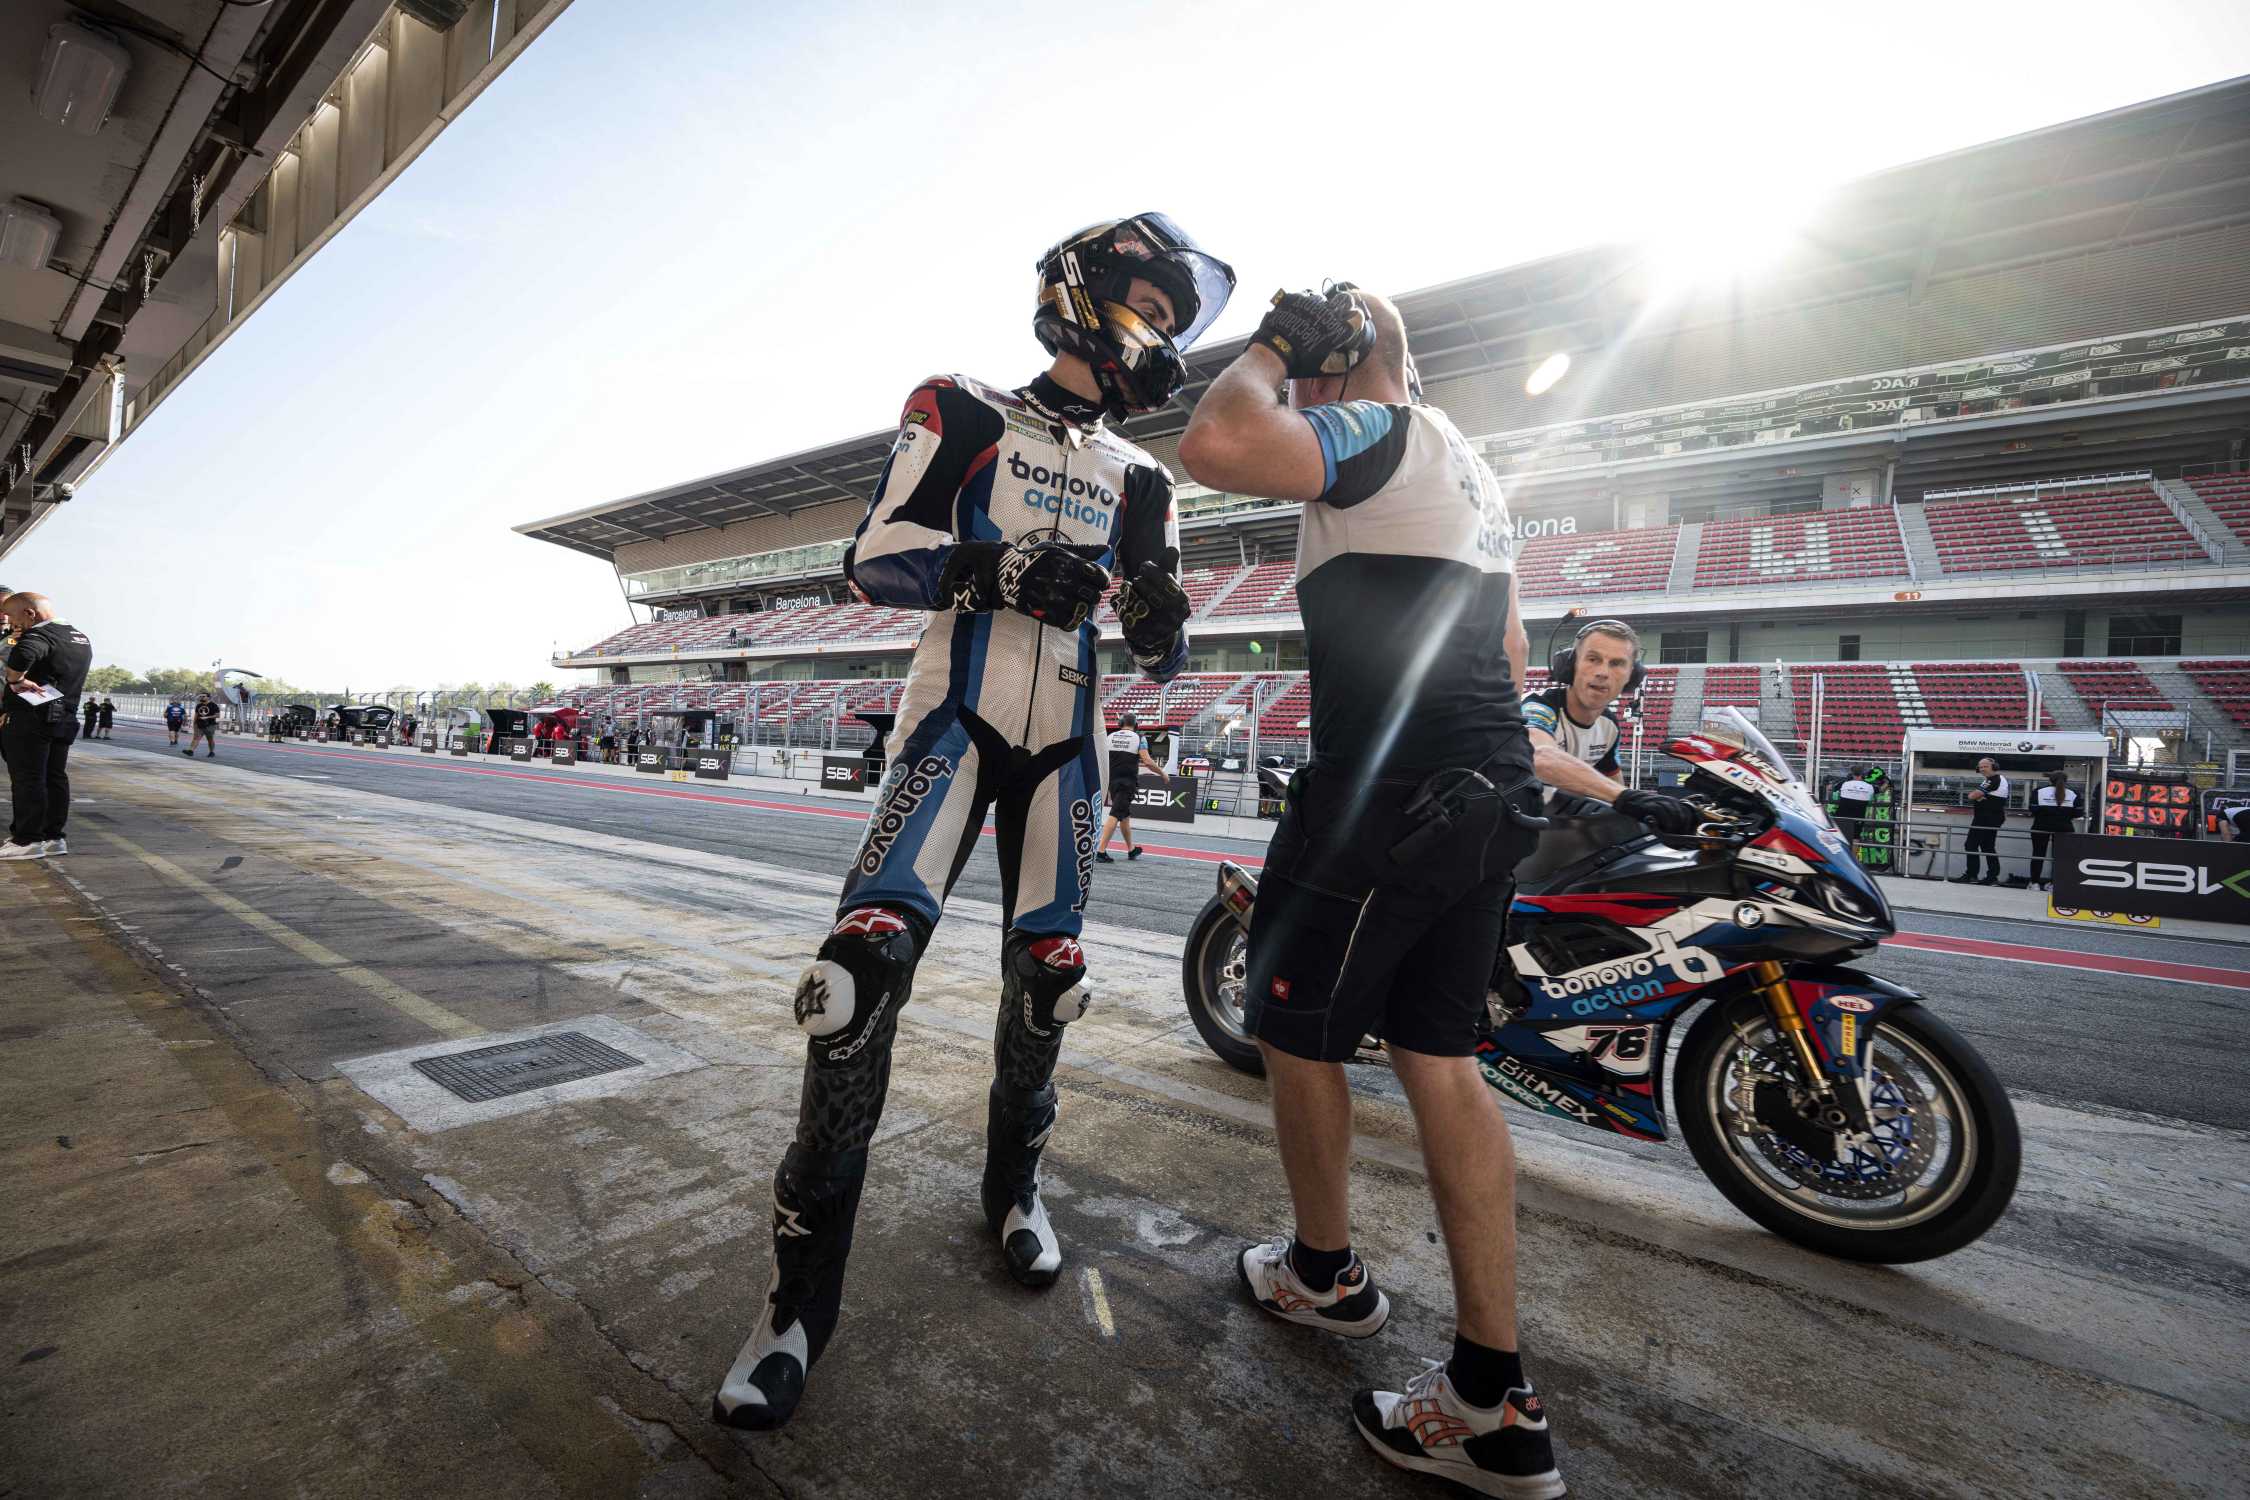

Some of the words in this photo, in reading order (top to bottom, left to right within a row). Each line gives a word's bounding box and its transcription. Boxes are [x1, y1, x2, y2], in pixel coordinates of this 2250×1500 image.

[1007, 451, 1115, 506] bonovo
[1023, 488, 1109, 531] action
[663, 608, 698, 622] Barcelona
[776, 594, 821, 611] Barcelona
[641, 752, 663, 765] SBK
[699, 757, 727, 770] SBK
[826, 766, 860, 782] SBK
[861, 755, 952, 876] bonovo
[1130, 789, 1190, 808] SBK
[2078, 858, 2250, 899] SBK
[1539, 957, 1654, 999] bonovo
[1571, 979, 1665, 1016] action
[1837, 999, 1868, 1011] HEL
[1584, 1026, 1650, 1062] 76
[1476, 1058, 1552, 1112] MOTOREX
[1498, 1055, 1599, 1124] BitMEX
